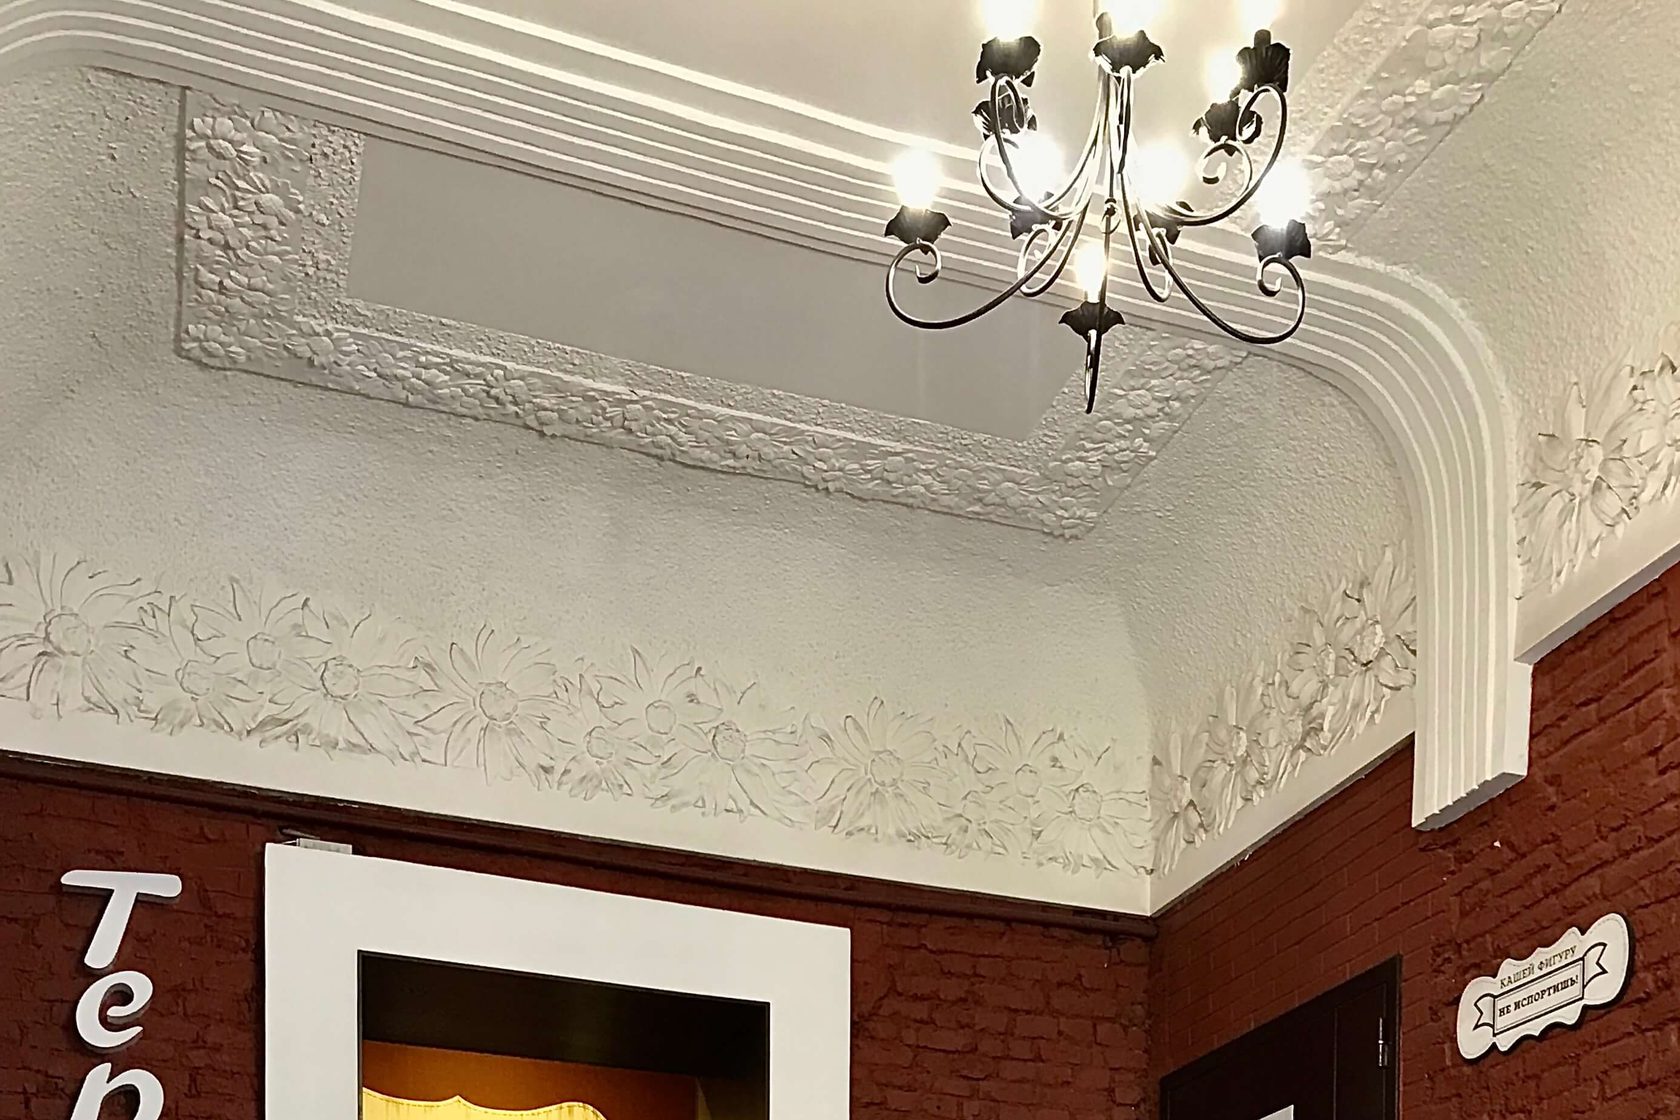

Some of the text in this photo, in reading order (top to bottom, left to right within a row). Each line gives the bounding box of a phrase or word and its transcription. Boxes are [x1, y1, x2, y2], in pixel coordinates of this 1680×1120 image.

[1500, 945, 1577, 989] КАШЕЙ ФИГУРУ
[1498, 975, 1579, 1018] НЕ ИСПОРТИШЬ!
